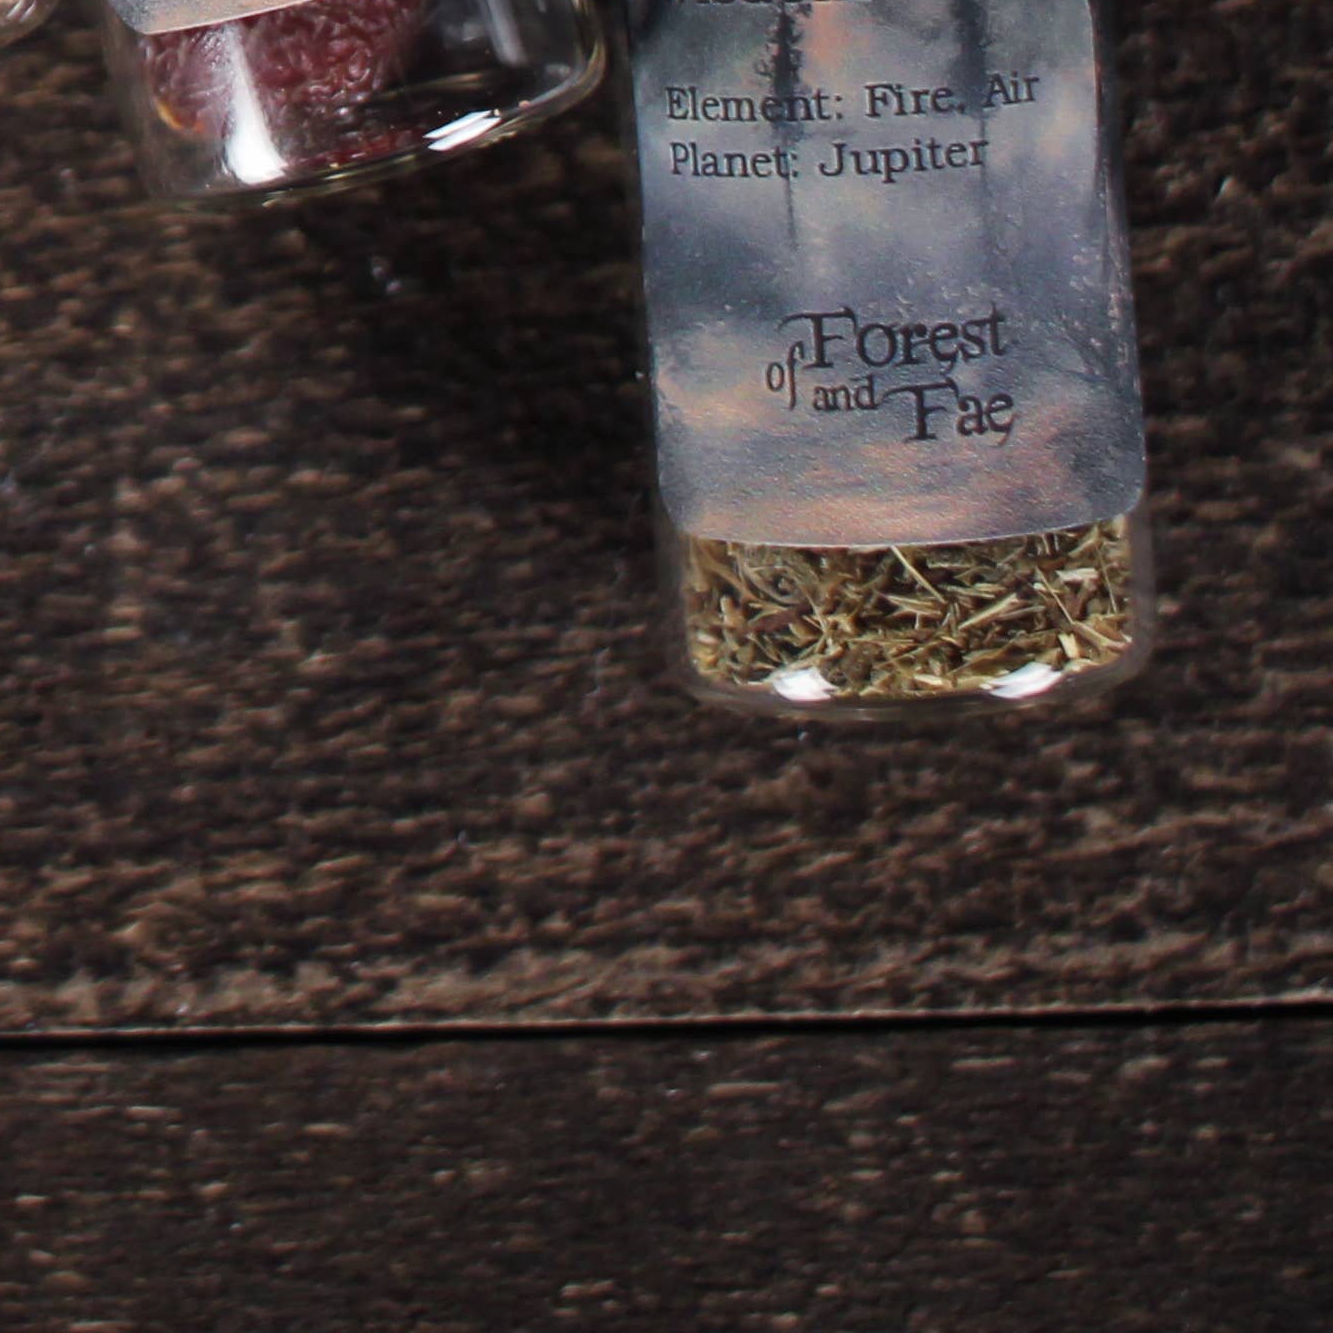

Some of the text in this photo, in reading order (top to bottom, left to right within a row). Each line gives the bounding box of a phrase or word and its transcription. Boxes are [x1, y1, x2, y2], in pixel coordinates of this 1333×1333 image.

[665, 85, 844, 123] Element:
[983, 73, 1040, 109] Air
[671, 138, 989, 184] Planet: Jupiter
[767, 305, 1009, 412] of Forest
[813, 376, 1016, 448] and Fae
